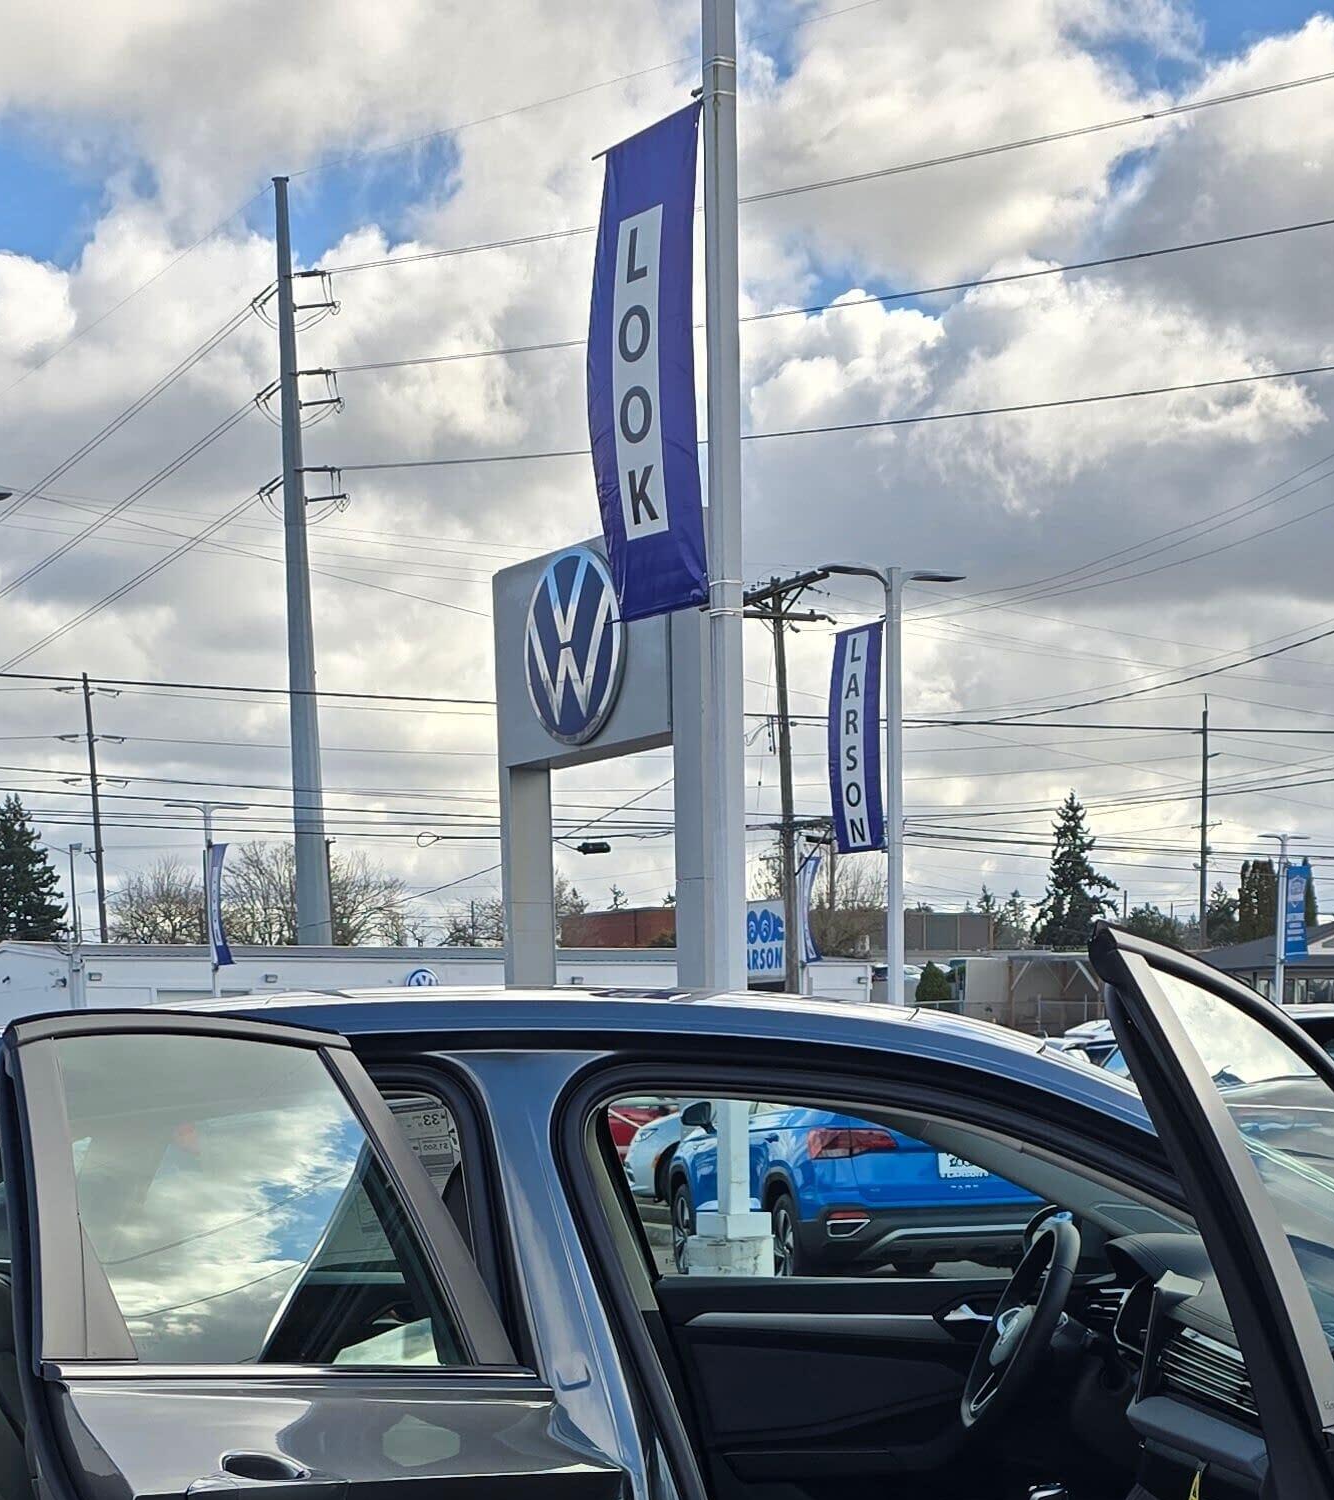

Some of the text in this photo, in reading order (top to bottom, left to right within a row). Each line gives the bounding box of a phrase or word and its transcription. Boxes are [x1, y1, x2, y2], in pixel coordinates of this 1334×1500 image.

[618, 226, 659, 526] LOOK
[524, 546, 622, 745] VW
[844, 637, 866, 844] LARSON
